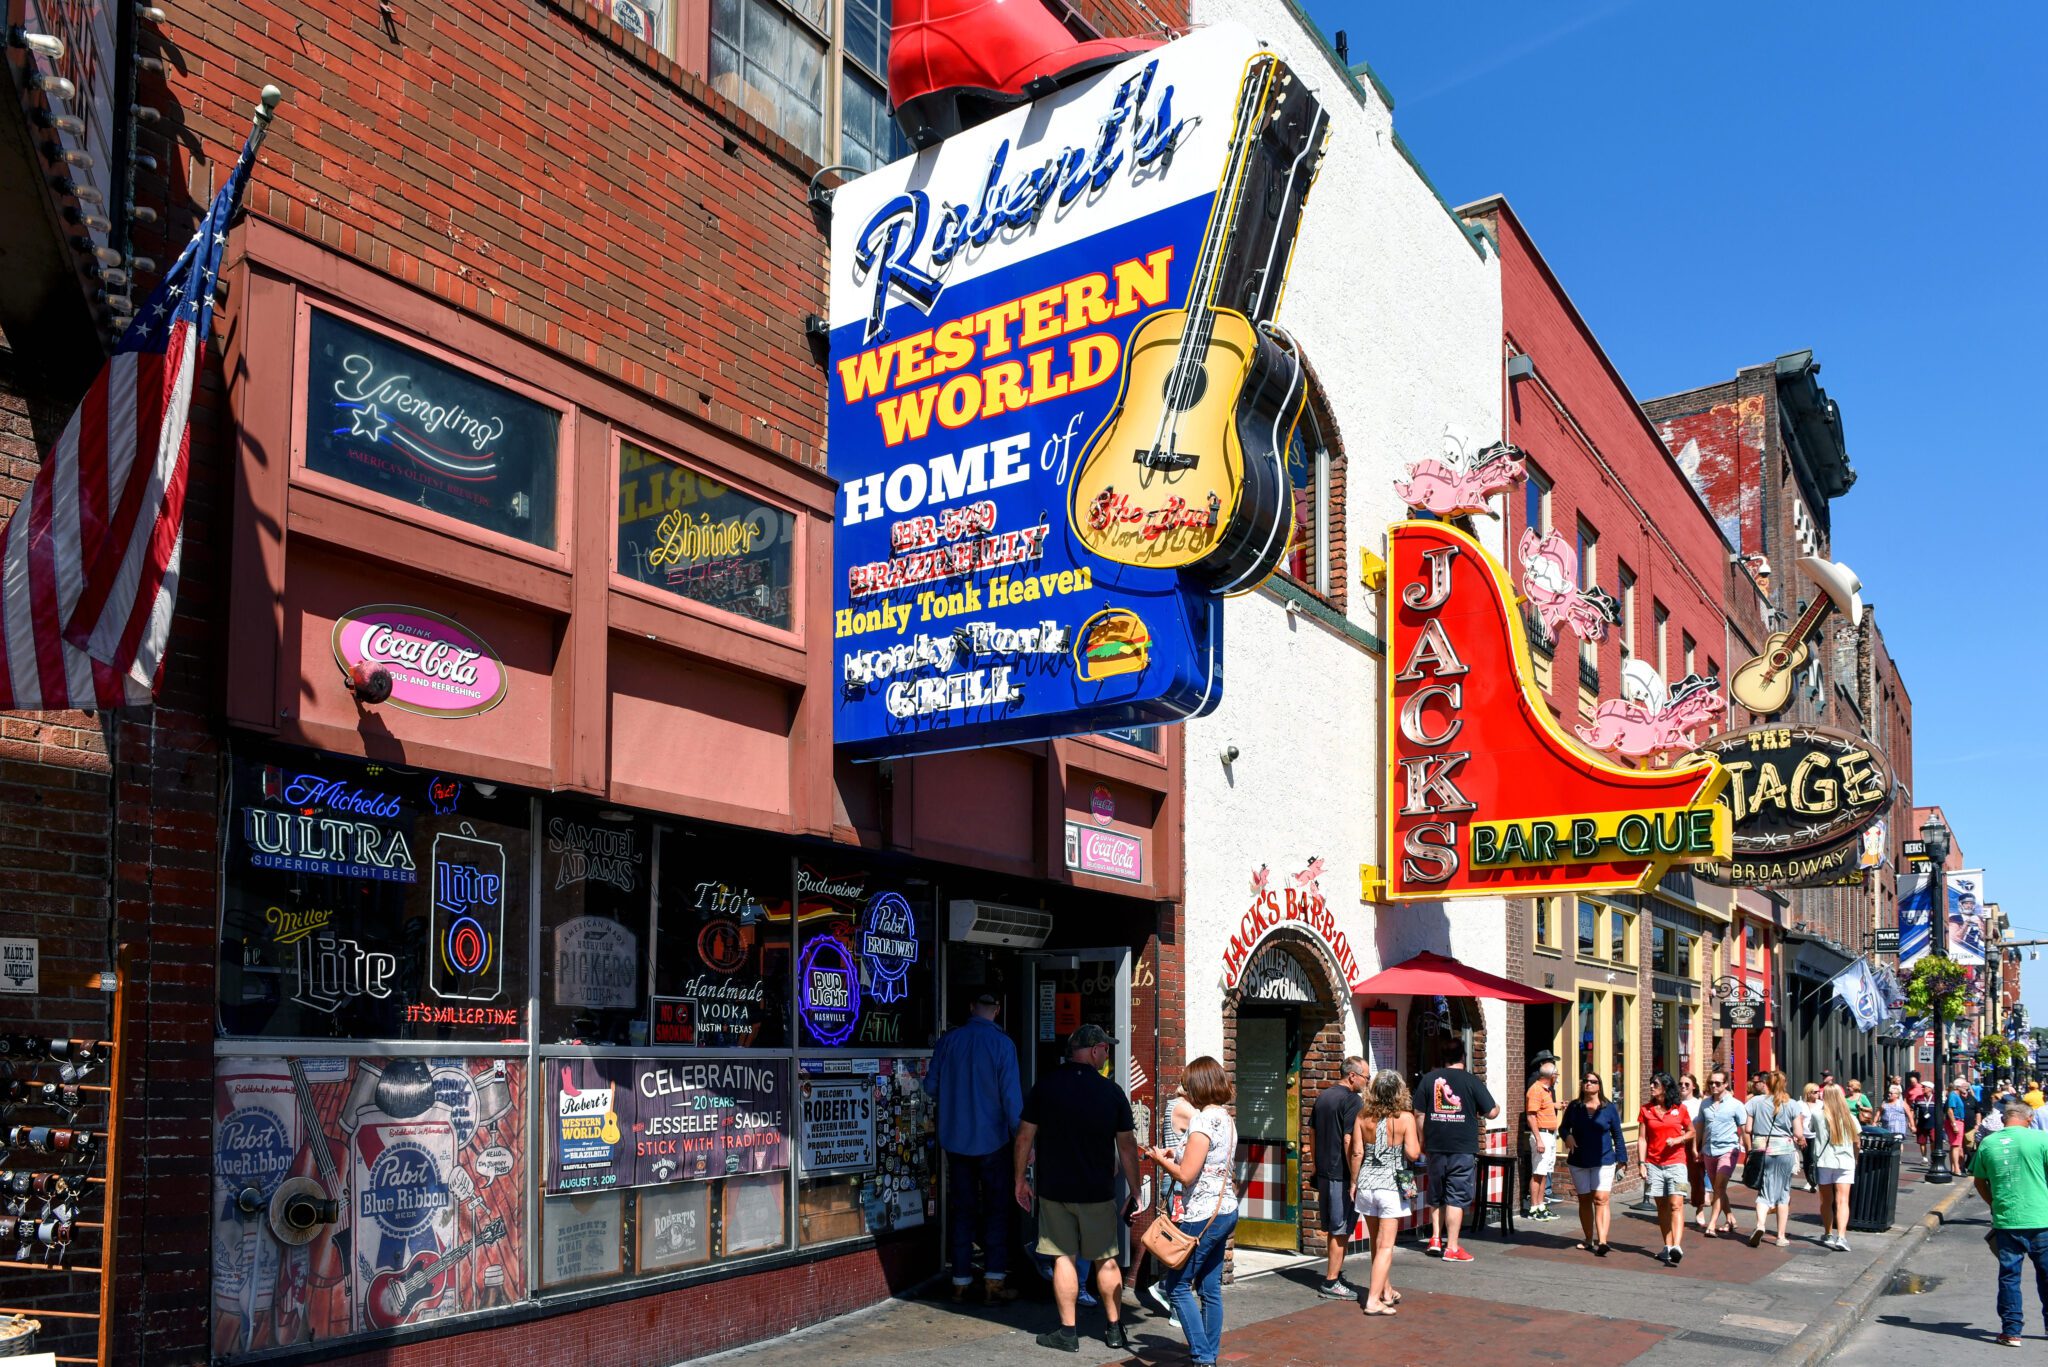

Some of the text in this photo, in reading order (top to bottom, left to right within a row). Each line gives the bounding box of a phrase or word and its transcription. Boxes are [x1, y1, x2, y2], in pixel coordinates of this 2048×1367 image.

[855, 58, 1188, 346] Robert's
[836, 245, 1175, 404] WESTERN
[334, 354, 504, 451] Yuengling
[876, 332, 1122, 448] WORLD
[404, 468, 446, 489] OLDEST
[842, 411, 1085, 527] HOME of
[649, 509, 761, 566] Shiner
[835, 566, 1093, 639] Honky Tonk Heaven
[396, 623, 432, 639] DRINK
[359, 622, 483, 686] Coca-Cola
[410, 673, 429, 687] AND
[431, 682, 481, 699] REFRESHING
[886, 665, 1020, 718] GRILL
[1748, 729, 1792, 751] THE
[284, 773, 401, 818] Michelob
[252, 809, 416, 871] ULTRA
[549, 817, 642, 864] SAMUEL
[1086, 833, 1135, 868] Coca-Cola
[1473, 809, 1716, 866] BAR-B-QUE
[253, 854, 416, 883] SUPERIOR LIGHT BEER
[555, 853, 635, 892] ADAMS
[1732, 847, 1850, 879] BROADWAY
[436, 861, 500, 914] Lite
[797, 870, 865, 898] Budweiser
[694, 880, 755, 917] Tito's
[266, 906, 334, 936] Miller
[564, 919, 603, 944] AMERICAN
[878, 905, 907, 935] Pabst
[866, 935, 916, 959] BROADWAY
[1222, 888, 1281, 988] JACK'S
[4, 946, 34, 960] MADE IN
[4, 963, 34, 978] AMERICA
[291, 935, 396, 1014] Lite
[559, 950, 635, 988] PICKERS
[813, 971, 841, 990] BUD
[685, 974, 764, 1002] Handmade
[809, 987, 847, 1007] LIGHT
[407, 1003, 517, 1025] IT'S MILLER TIME
[661, 1004, 673, 1022] NO
[701, 1003, 749, 1019] VODKA
[814, 1012, 846, 1022] NASHVILLE
[656, 1022, 693, 1041] SMOKING
[730, 1023, 753, 1034] TEXAS
[859, 1010, 903, 1043] ATM
[640, 1064, 774, 1098] CELEBRATING
[817, 1089, 853, 1099] WELCOME TO
[435, 1091, 471, 1107] PABST
[562, 1093, 608, 1115] Robert's
[694, 1096, 734, 1110] 20 YEARS
[803, 1097, 870, 1122] ROBERT'S
[561, 1117, 601, 1127] WESTERN
[562, 1126, 602, 1140] WORLD
[735, 1111, 782, 1129] SADDLE
[811, 1120, 859, 1133] WESTERN WORLD
[223, 1121, 276, 1151] Pabst
[637, 1132, 781, 1157] STICK WITH TRADITION
[808, 1138, 864, 1150] PROUDLY SERVING
[812, 1131, 839, 1139] NASHVILLE
[840, 1129, 867, 1137] TRADITION
[570, 1150, 611, 1160] BRAZILBILLY
[815, 1149, 859, 1165] Budweiser
[380, 1155, 429, 1187] Pabst
[560, 1175, 617, 1189] AUGUST 5, 2019
[363, 1187, 447, 1215] Blue Ribbon
[558, 1221, 607, 1236] ROBERT'S
[655, 1210, 696, 1237] ROBERT'S
[557, 1263, 582, 1277] TASTE
